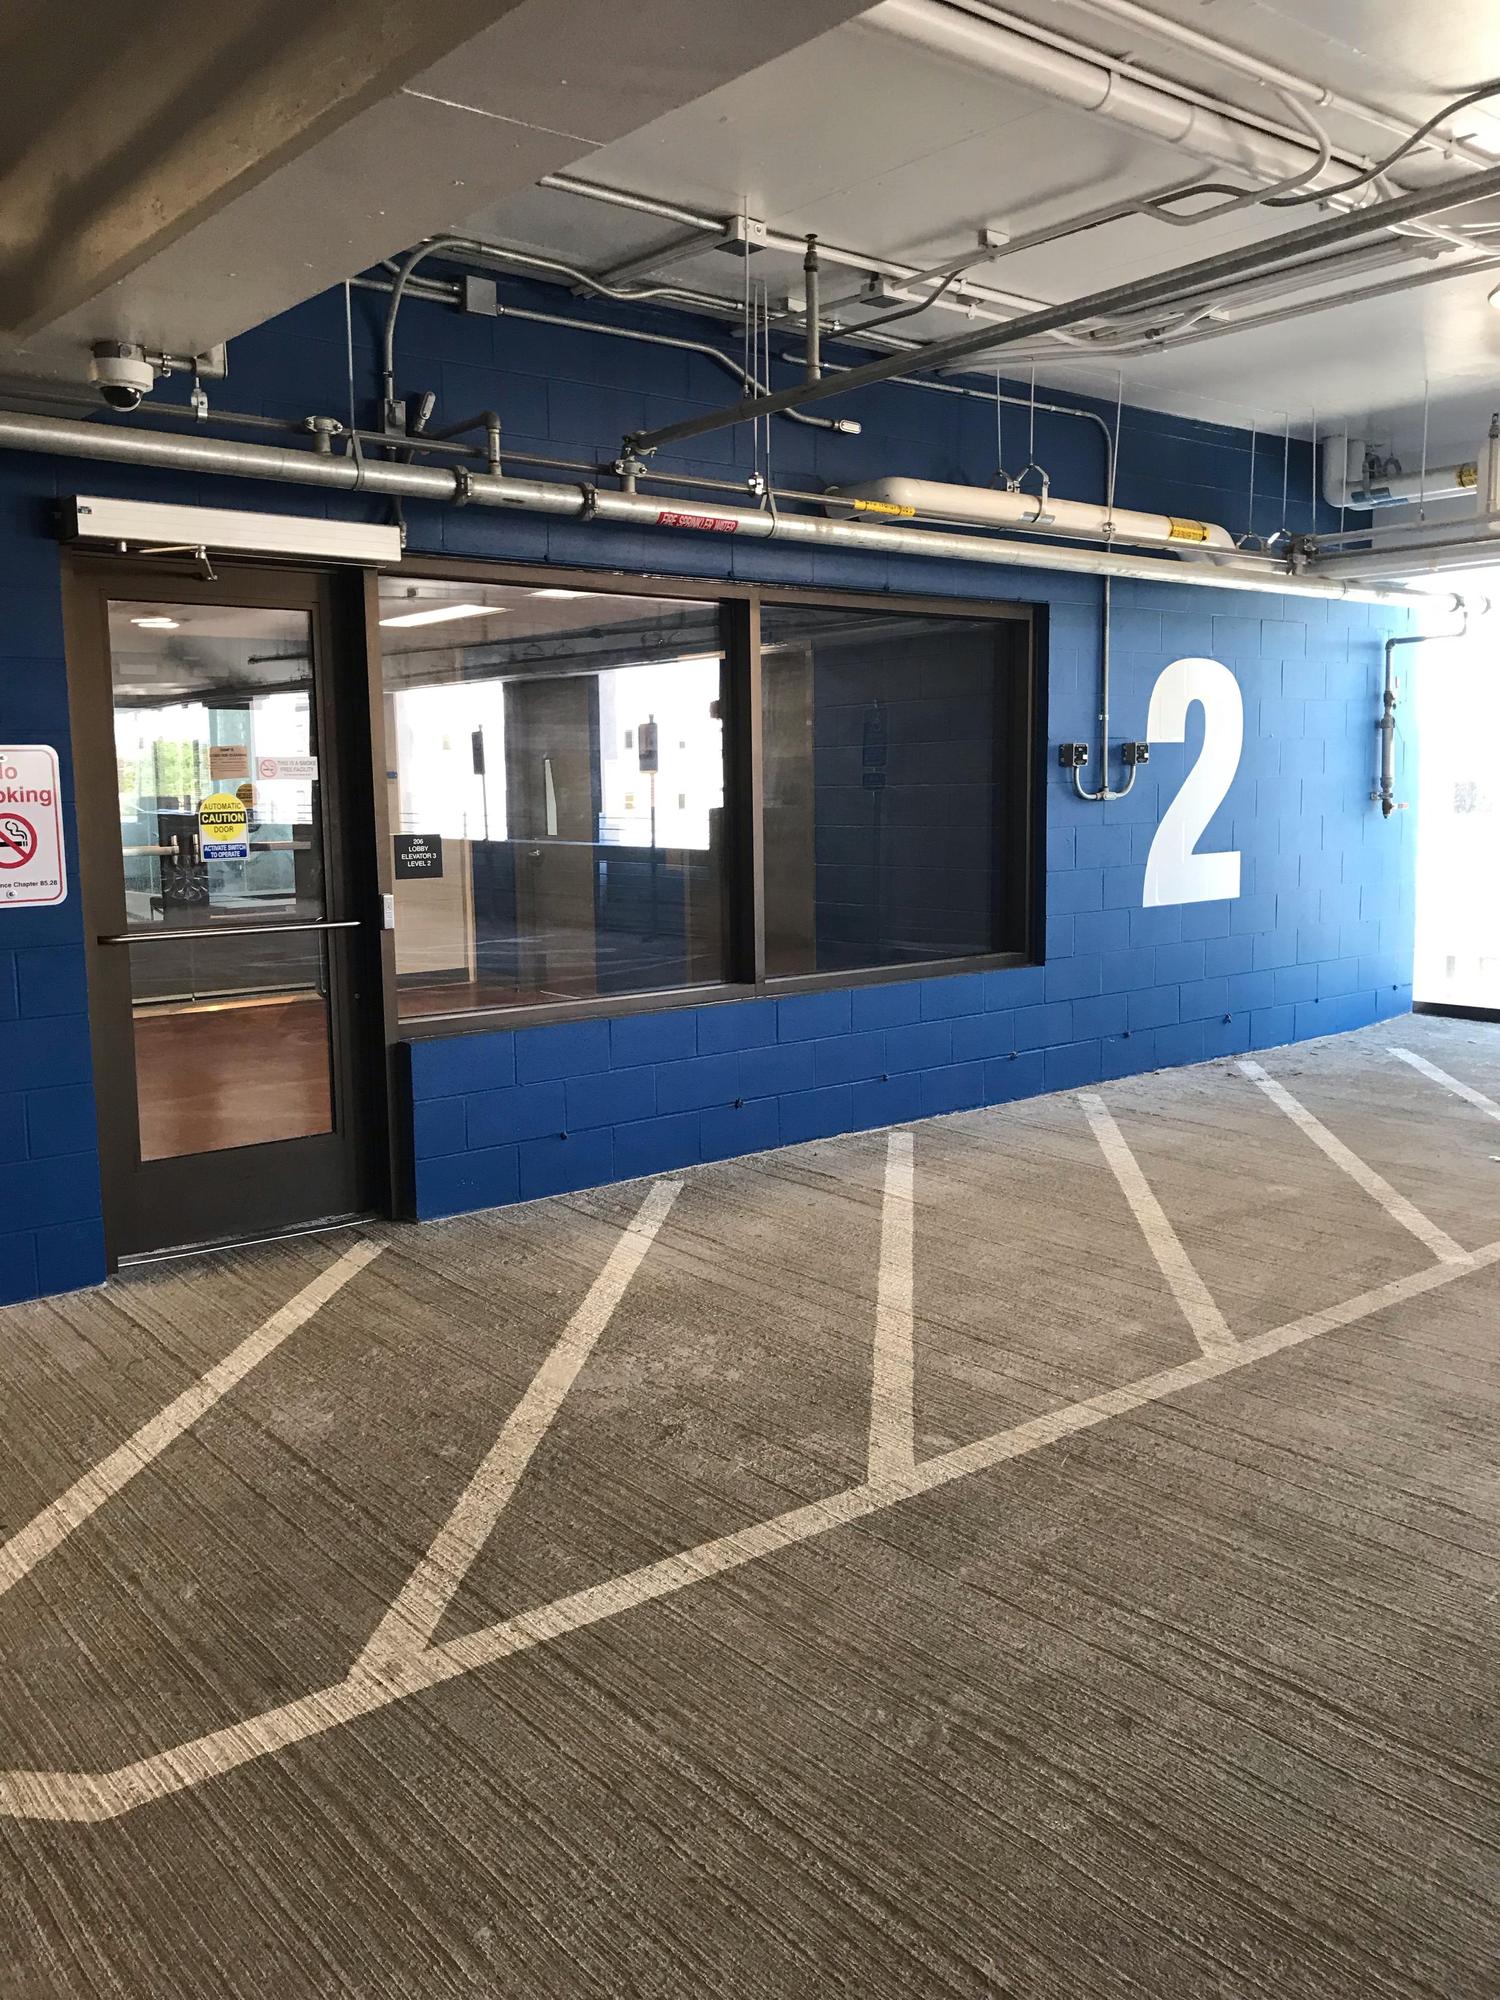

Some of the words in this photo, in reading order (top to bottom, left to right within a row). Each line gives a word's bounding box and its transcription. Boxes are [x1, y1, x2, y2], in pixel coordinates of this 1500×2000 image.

[661, 513, 678, 526] FIRE
[1143, 658, 1243, 908] 2
[203, 802, 242, 810] AUTOMATIC
[201, 813, 245, 823] CAUTION
[213, 825, 234, 833] DOOR
